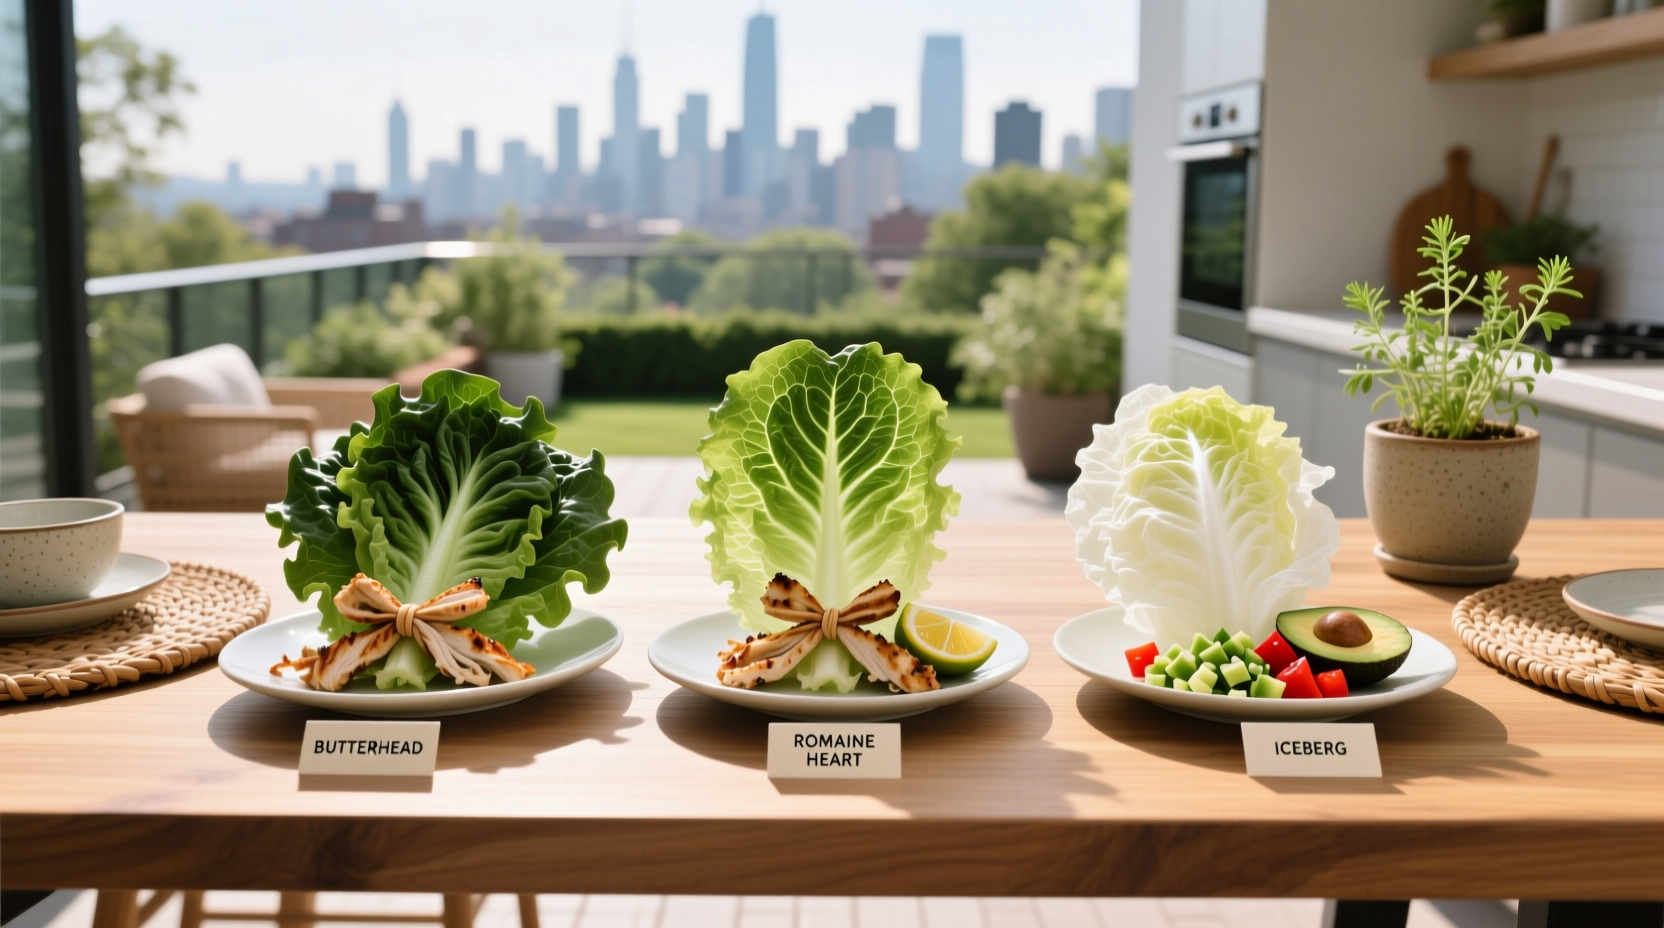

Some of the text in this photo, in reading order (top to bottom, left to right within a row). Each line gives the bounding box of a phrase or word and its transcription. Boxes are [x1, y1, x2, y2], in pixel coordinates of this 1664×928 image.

[313, 739, 424, 755] BUTTERHEAD
[794, 733, 875, 748] ROMAINE
[1274, 741, 1347, 756] ICEBERG
[806, 752, 863, 767] HEART
